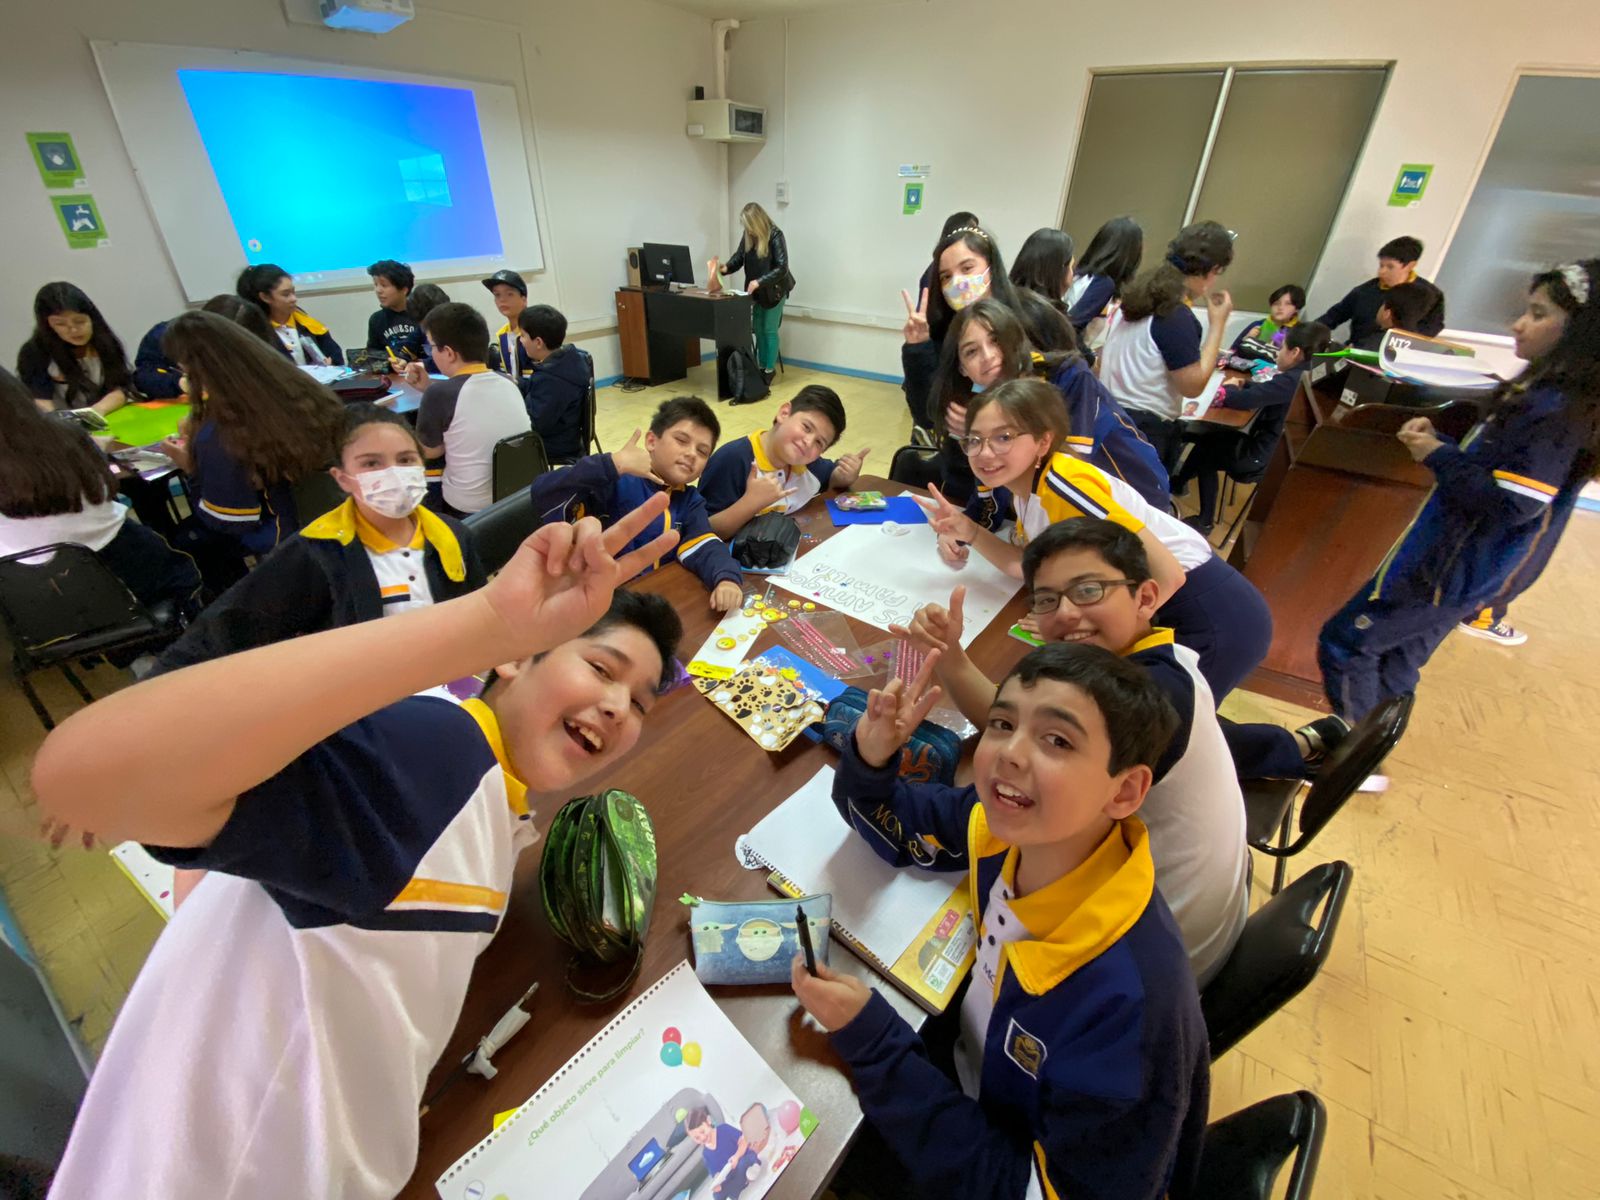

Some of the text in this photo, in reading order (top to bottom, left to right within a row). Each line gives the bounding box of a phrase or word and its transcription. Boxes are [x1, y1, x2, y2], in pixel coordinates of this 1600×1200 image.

[1388, 336, 1412, 349] NT2
[527, 1027, 645, 1147] ¿Qué objeto sirve para limpiar?
